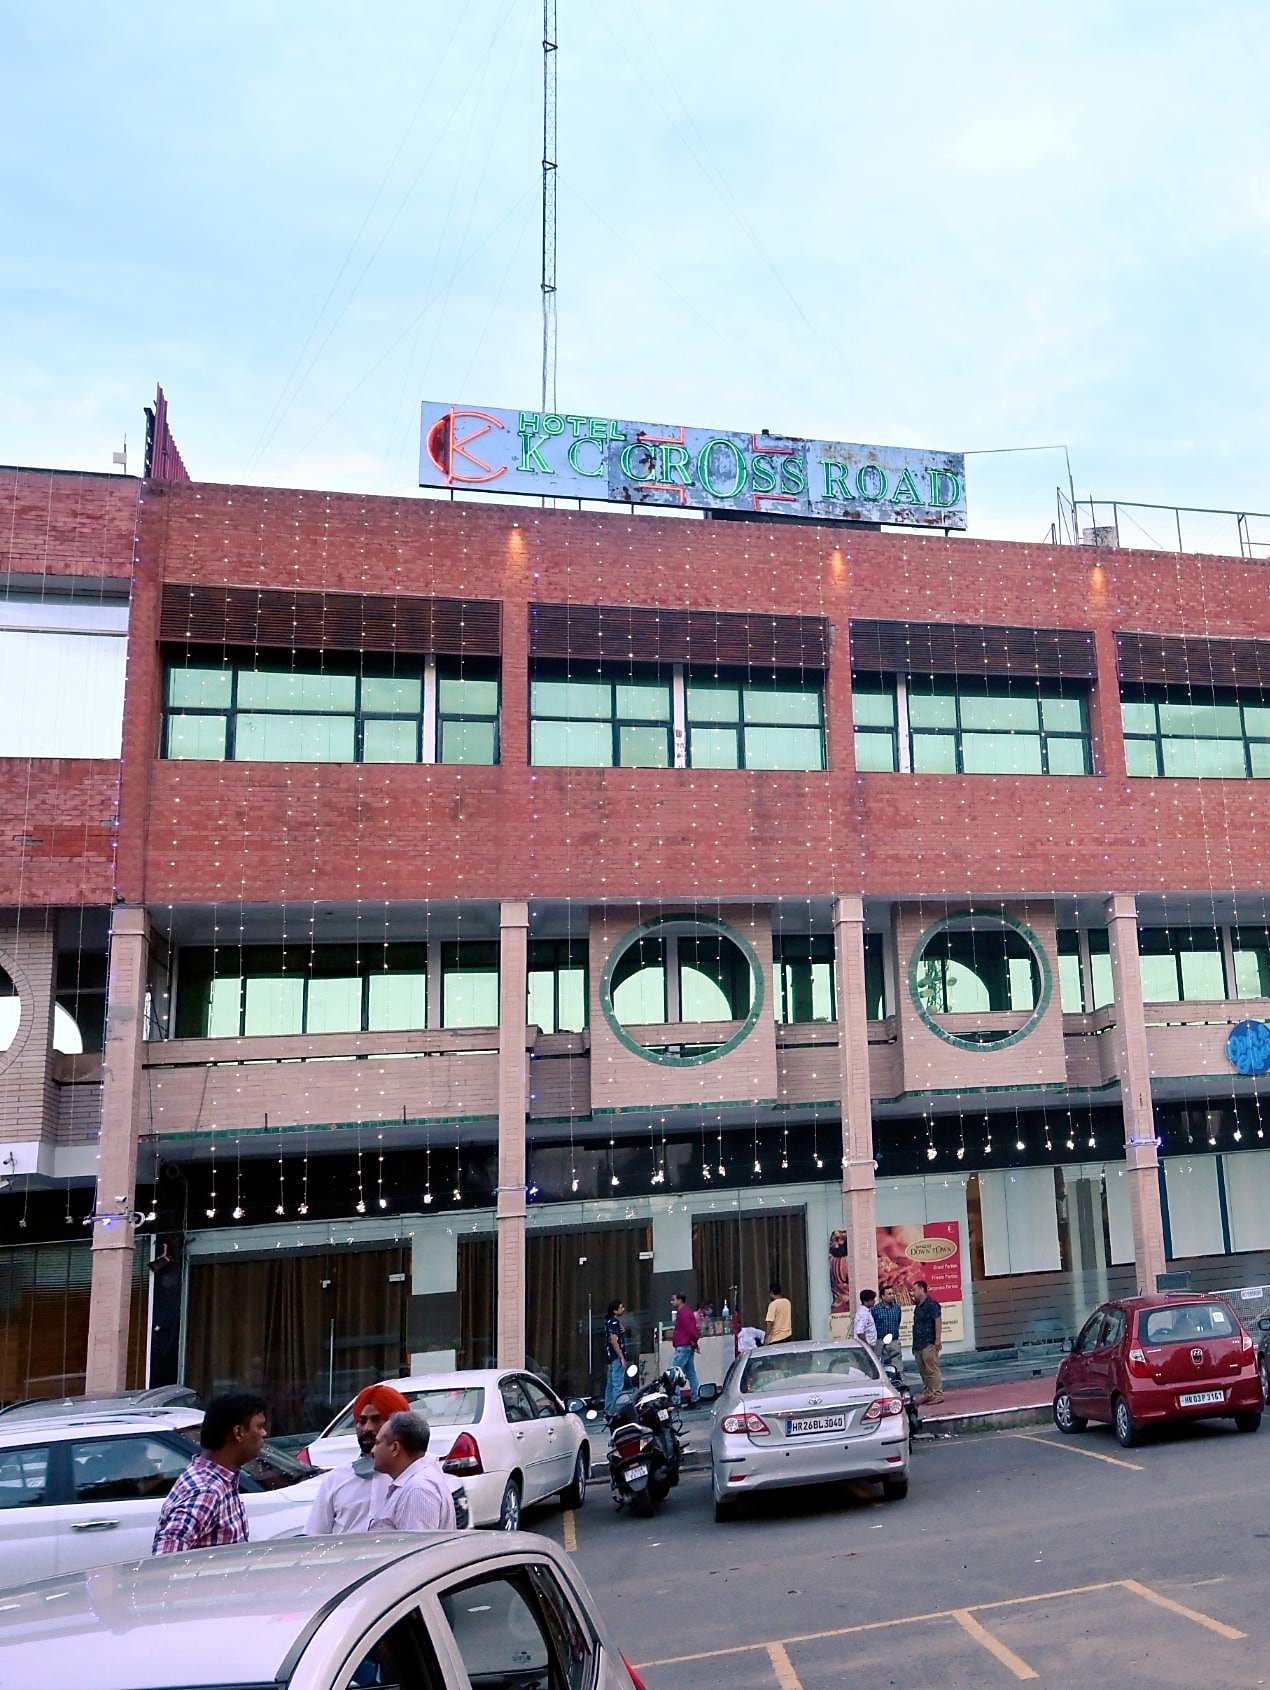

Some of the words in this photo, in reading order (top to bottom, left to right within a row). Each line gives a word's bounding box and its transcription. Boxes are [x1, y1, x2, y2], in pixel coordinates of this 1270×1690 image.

[518, 411, 627, 441] HOTEL
[619, 438, 808, 500] CROSS
[820, 459, 962, 509] ROAD
